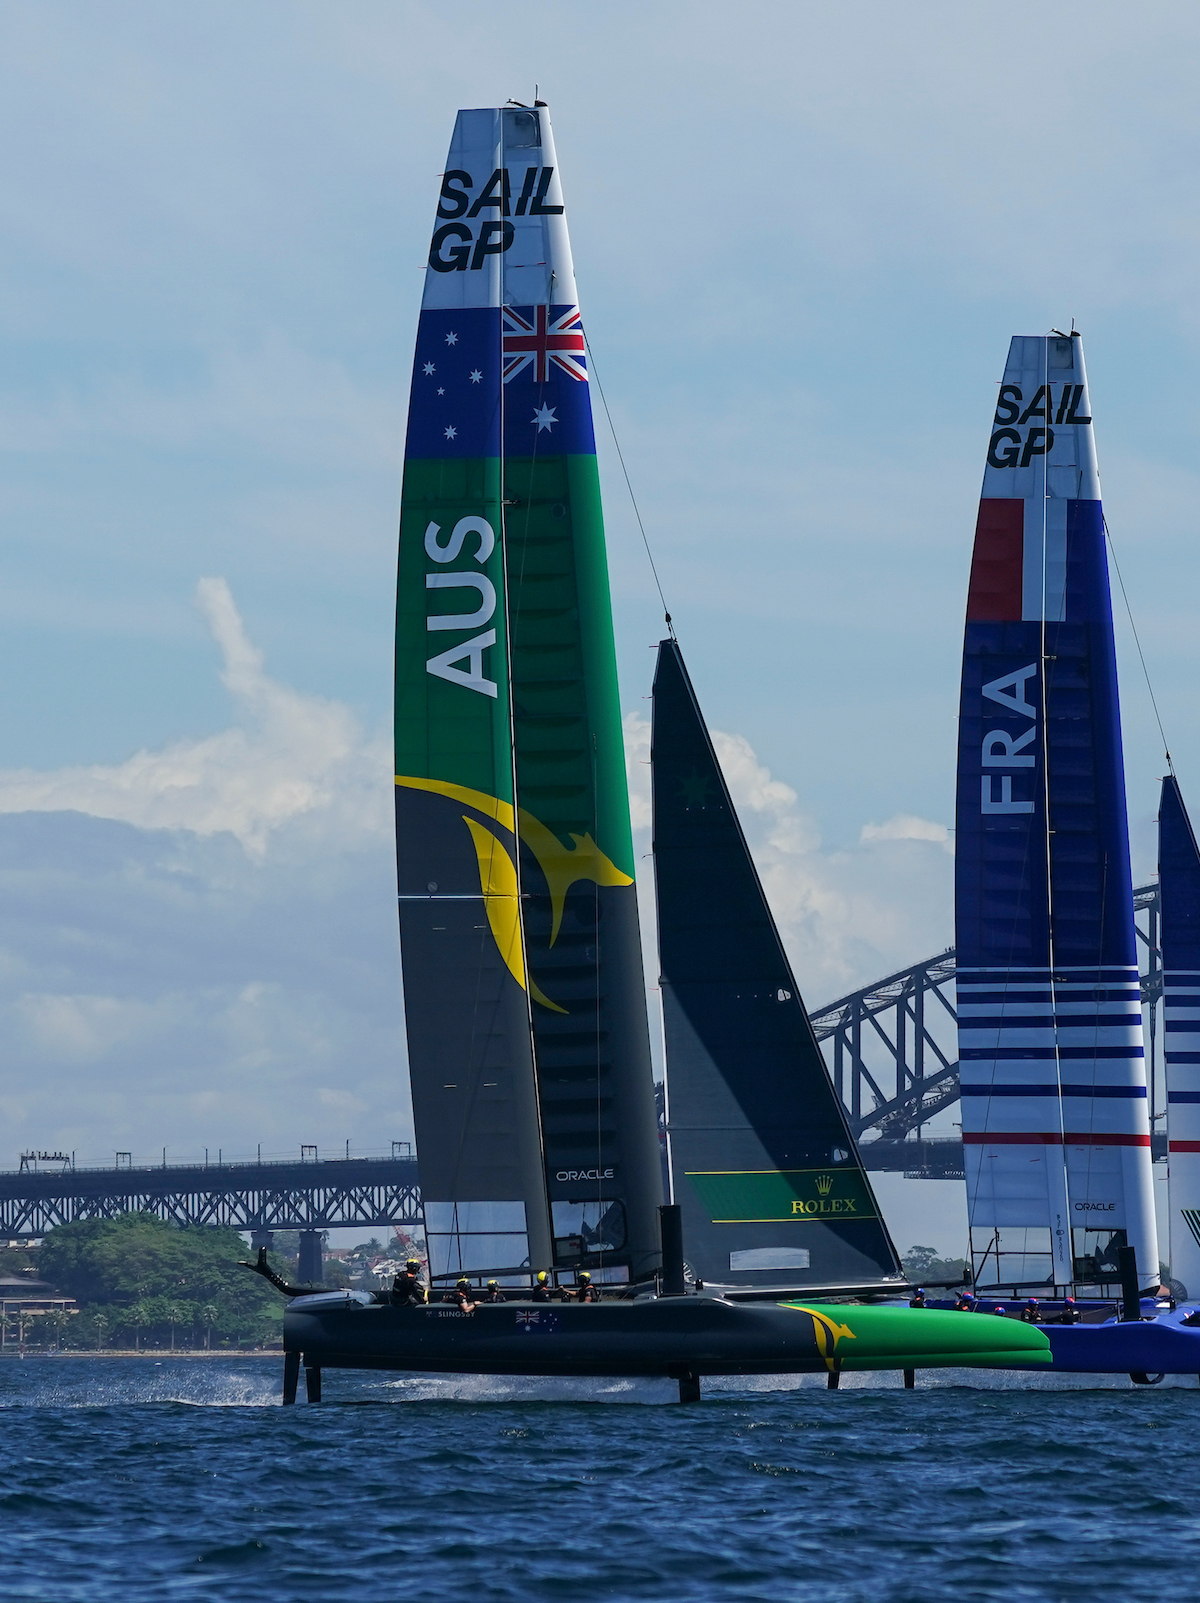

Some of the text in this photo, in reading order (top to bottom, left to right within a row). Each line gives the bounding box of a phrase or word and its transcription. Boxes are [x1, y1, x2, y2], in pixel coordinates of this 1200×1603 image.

[436, 166, 565, 220] SAIL
[428, 220, 516, 273] GP
[993, 384, 1092, 426] SAIL
[986, 427, 1055, 469] GP
[424, 515, 498, 699] AUS
[980, 662, 1037, 815] FRA
[555, 1168, 614, 1182] ORACLE
[791, 1198, 857, 1214] ROLEX
[1074, 1202, 1116, 1212] ORACLE
